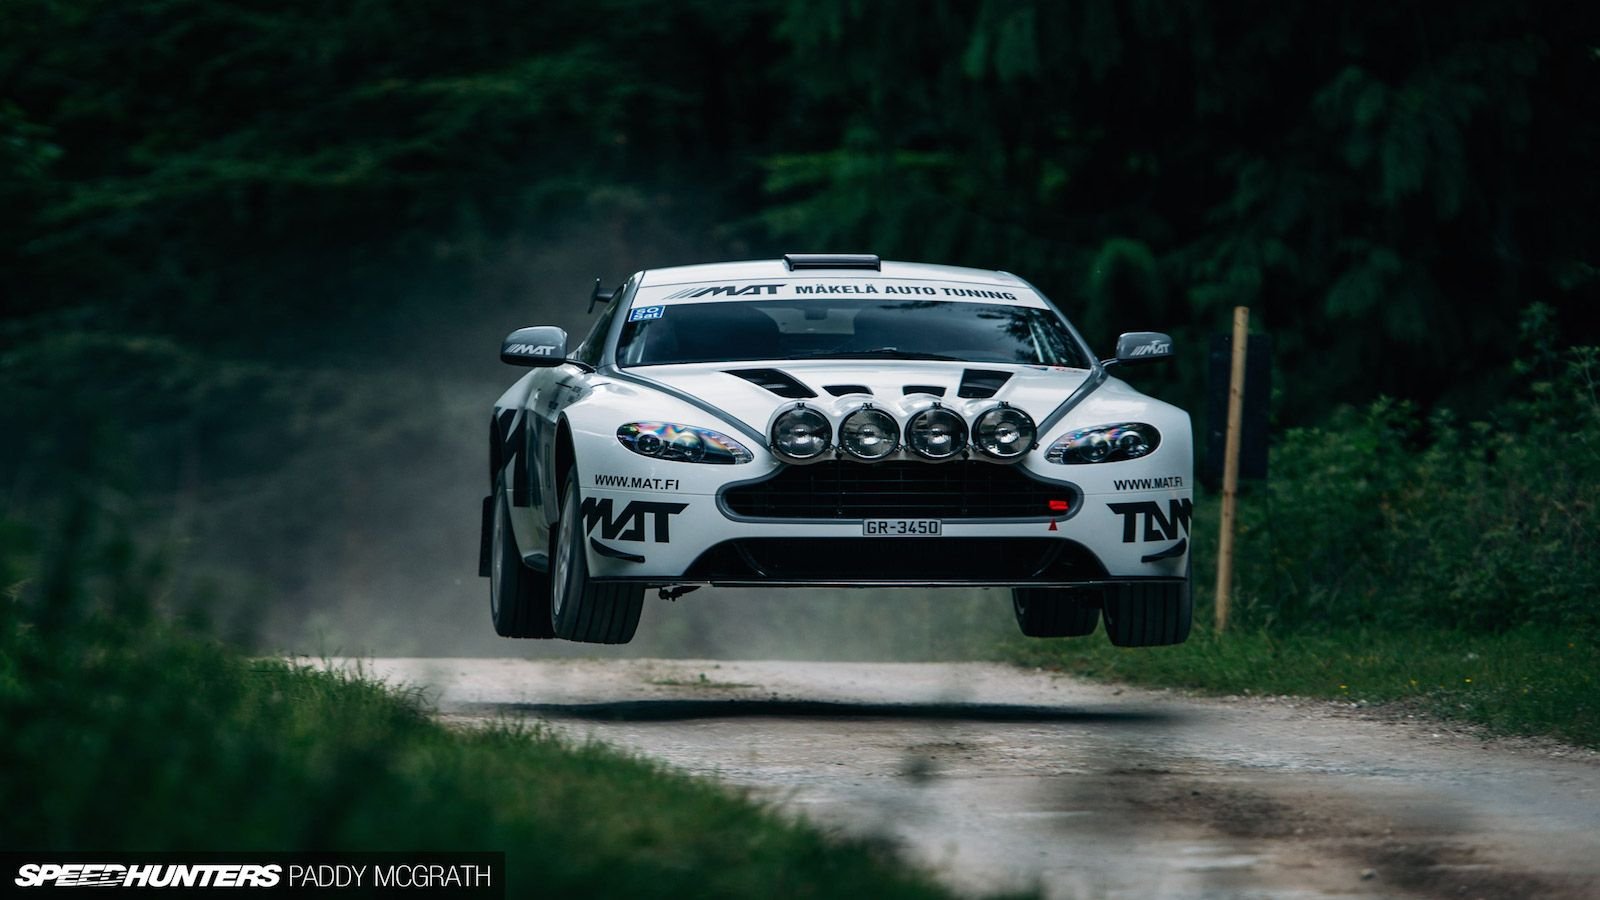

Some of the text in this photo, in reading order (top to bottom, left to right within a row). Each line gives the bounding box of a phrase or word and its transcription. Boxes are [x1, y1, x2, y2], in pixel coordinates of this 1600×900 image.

[795, 284, 879, 294] MÄKELÄ
[885, 286, 937, 296] AUTO
[940, 287, 1018, 301] TUNING
[594, 474, 680, 491] WWW.MAT.FI
[1113, 476, 1184, 491] WWW.MAT.FI
[580, 496, 690, 543] MAT
[867, 521, 939, 534] GR-3450
